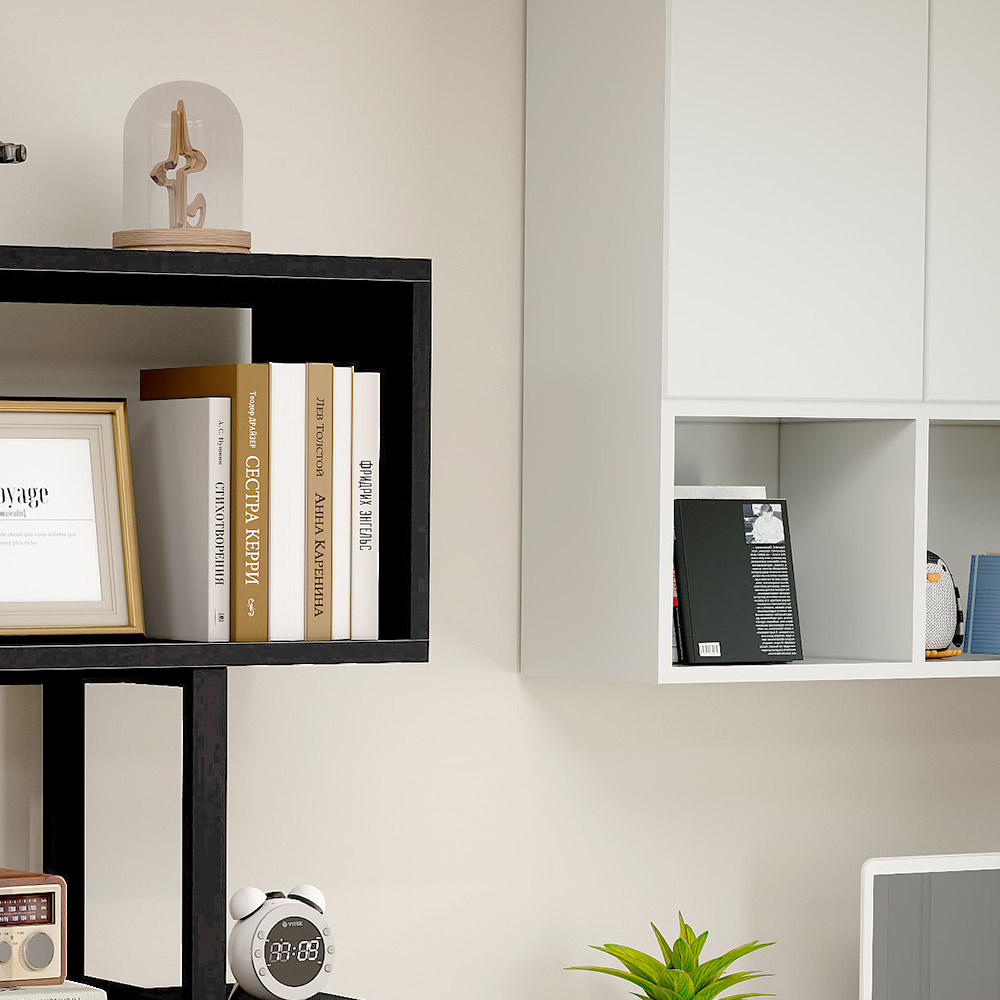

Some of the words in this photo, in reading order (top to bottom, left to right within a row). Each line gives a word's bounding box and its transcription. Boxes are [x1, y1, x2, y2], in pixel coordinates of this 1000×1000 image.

[248, 391, 256, 416] Теодор
[248, 416, 257, 449] ДРАЙЗЕР
[316, 424, 325, 477] ТОЛСТОЙ
[245, 456, 260, 524] СЕСТРА
[358, 460, 374, 505] ФРИДРИХ
[215, 482, 225, 585] СТИХОТВОРЕНИЯ
[315, 493, 326, 535] АННА
[359, 511, 373, 551] ЭНГЕЛЬС
[245, 528, 260, 585] КЕРРИ
[314, 540, 325, 617] КАРЕНИНА
